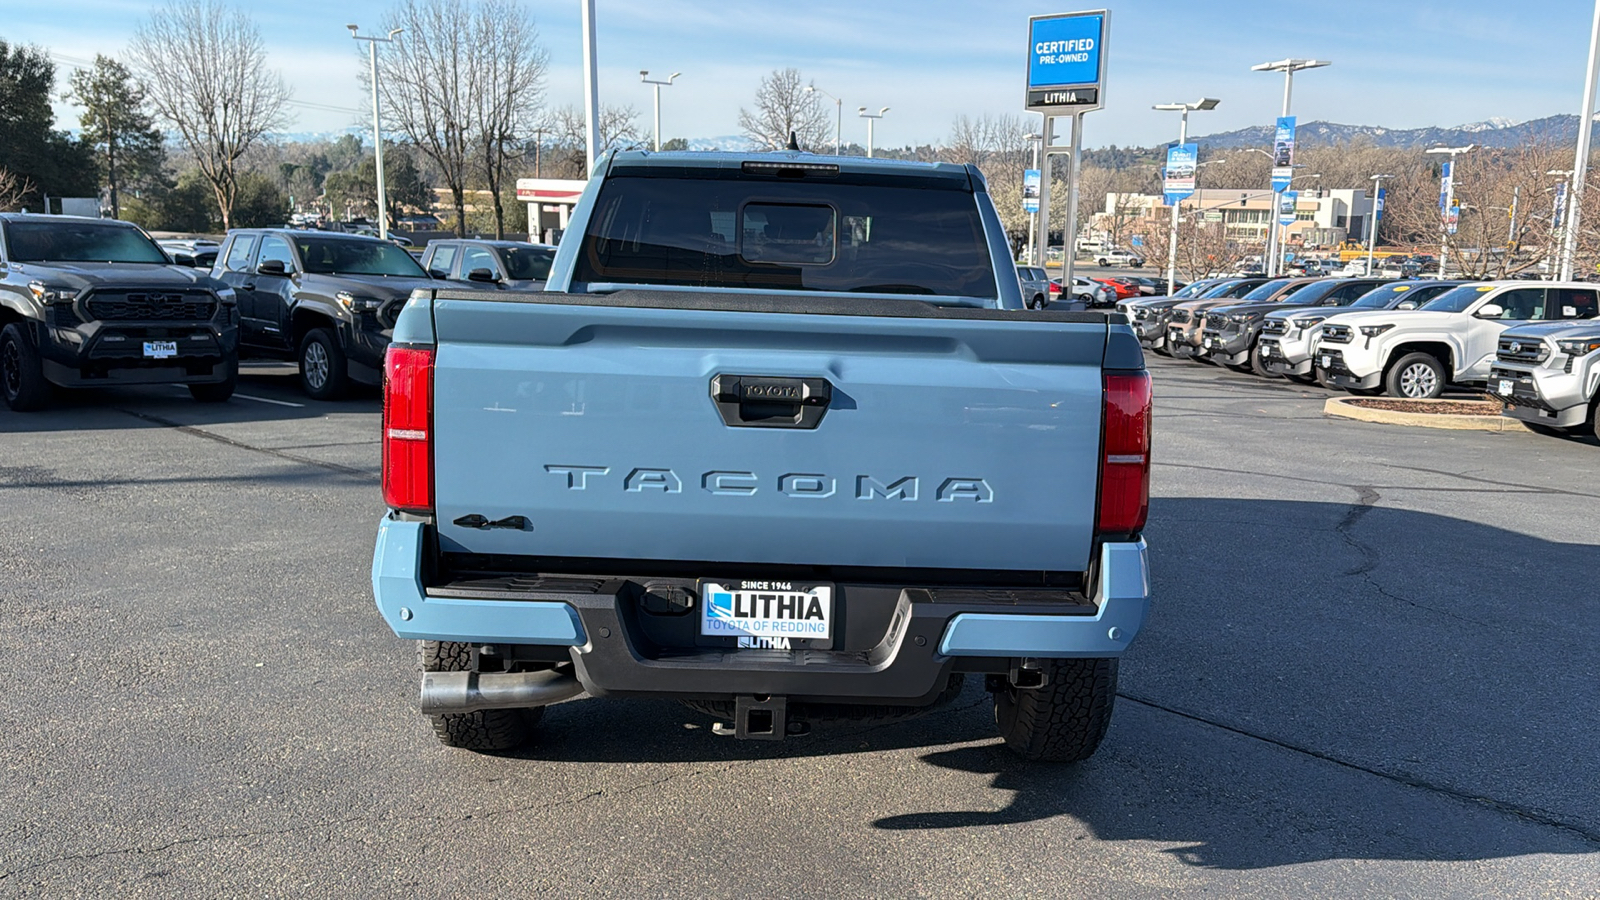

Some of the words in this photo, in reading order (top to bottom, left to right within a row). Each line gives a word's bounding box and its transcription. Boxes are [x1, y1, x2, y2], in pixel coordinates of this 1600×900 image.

[1035, 38, 1094, 54] CERTIFIED
[1039, 53, 1089, 65] PRE-OWNED
[1044, 92, 1077, 104] LITHIA
[744, 385, 800, 398] TOYOTA
[543, 464, 994, 503] TACOMA
[741, 580, 769, 590] SINCE
[771, 581, 792, 591] 1946
[734, 594, 824, 620] LITHIA
[706, 619, 750, 631] TOYOTA
[753, 620, 769, 632] OF
[772, 621, 825, 633] REDDING
[750, 636, 791, 650] LITHIA
